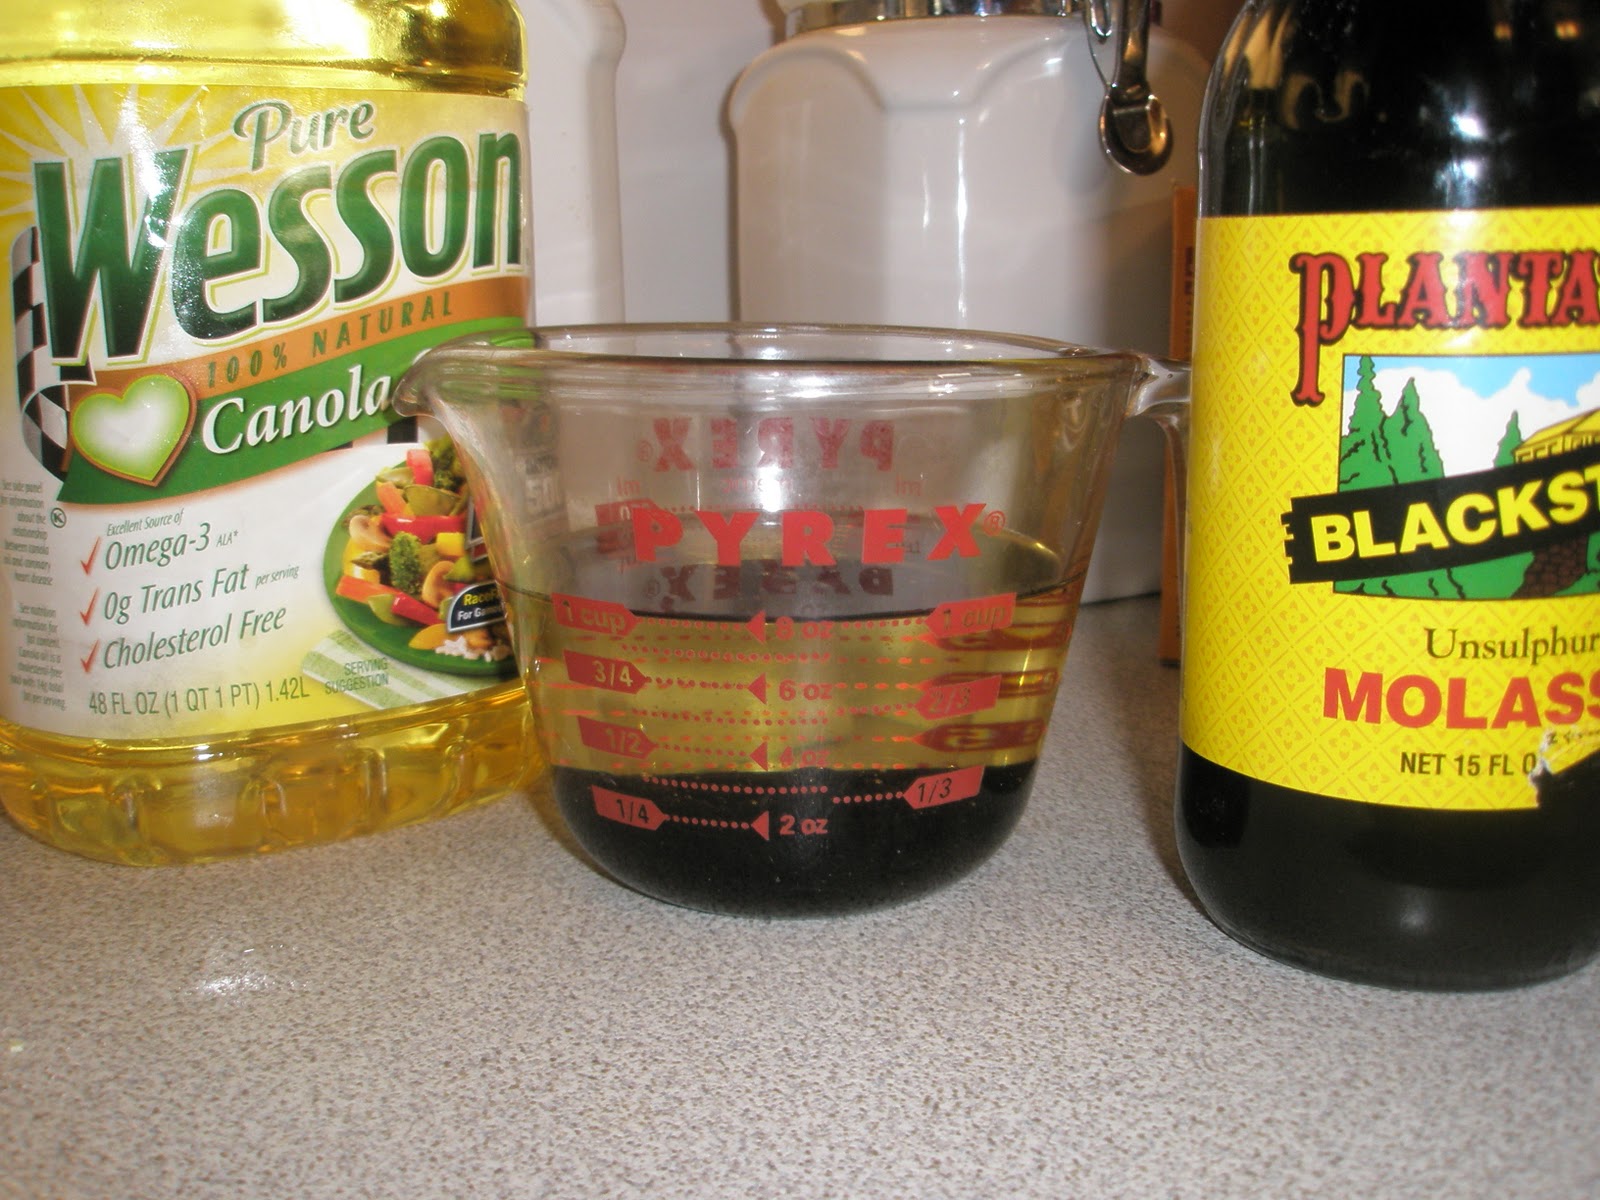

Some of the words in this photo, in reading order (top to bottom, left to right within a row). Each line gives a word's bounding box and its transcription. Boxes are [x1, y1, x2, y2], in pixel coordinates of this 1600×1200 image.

[233, 100, 374, 171] Pure
[33, 131, 523, 361] Wesson
[208, 342, 288, 387] 100%
[312, 291, 454, 353] NATURAL
[202, 363, 391, 454] Canola
[106, 518, 142, 537] Excellent
[144, 514, 173, 530] Source
[174, 508, 184, 526] of
[105, 522, 211, 570] Omega-3
[141, 578, 203, 614] Trans
[211, 563, 249, 598] Fat
[255, 572, 270, 588] per
[270, 564, 300, 585] serving
[582, 609, 625, 633] cup
[775, 616, 794, 640] 8
[802, 620, 833, 640] oz
[963, 605, 1006, 632] cup
[103, 612, 232, 669] Cholesterol
[239, 606, 287, 640] Free
[344, 657, 388, 676] SERVING
[592, 660, 633, 687] 3/4
[89, 691, 107, 716] 48
[111, 690, 132, 716] FL
[136, 690, 160, 715] OZ
[165, 690, 178, 718] (1
[186, 687, 209, 712] QT
[215, 686, 224, 709] 1
[230, 681, 260, 710] PT)
[265, 676, 310, 703] 1.42L
[324, 674, 389, 695] SUGGESTION
[778, 679, 796, 701] 6
[803, 683, 833, 701] oz
[929, 685, 970, 713] 2/3
[606, 727, 641, 755] 1/2
[778, 745, 794, 767] 4
[802, 749, 831, 767] oz
[1400, 752, 1446, 775] NET
[1454, 754, 1481, 777] 15
[1489, 754, 1514, 776] FL
[917, 777, 953, 803] 1/3
[616, 799, 649, 824] 1/4
[780, 815, 796, 836] 2
[801, 818, 828, 836] oz
